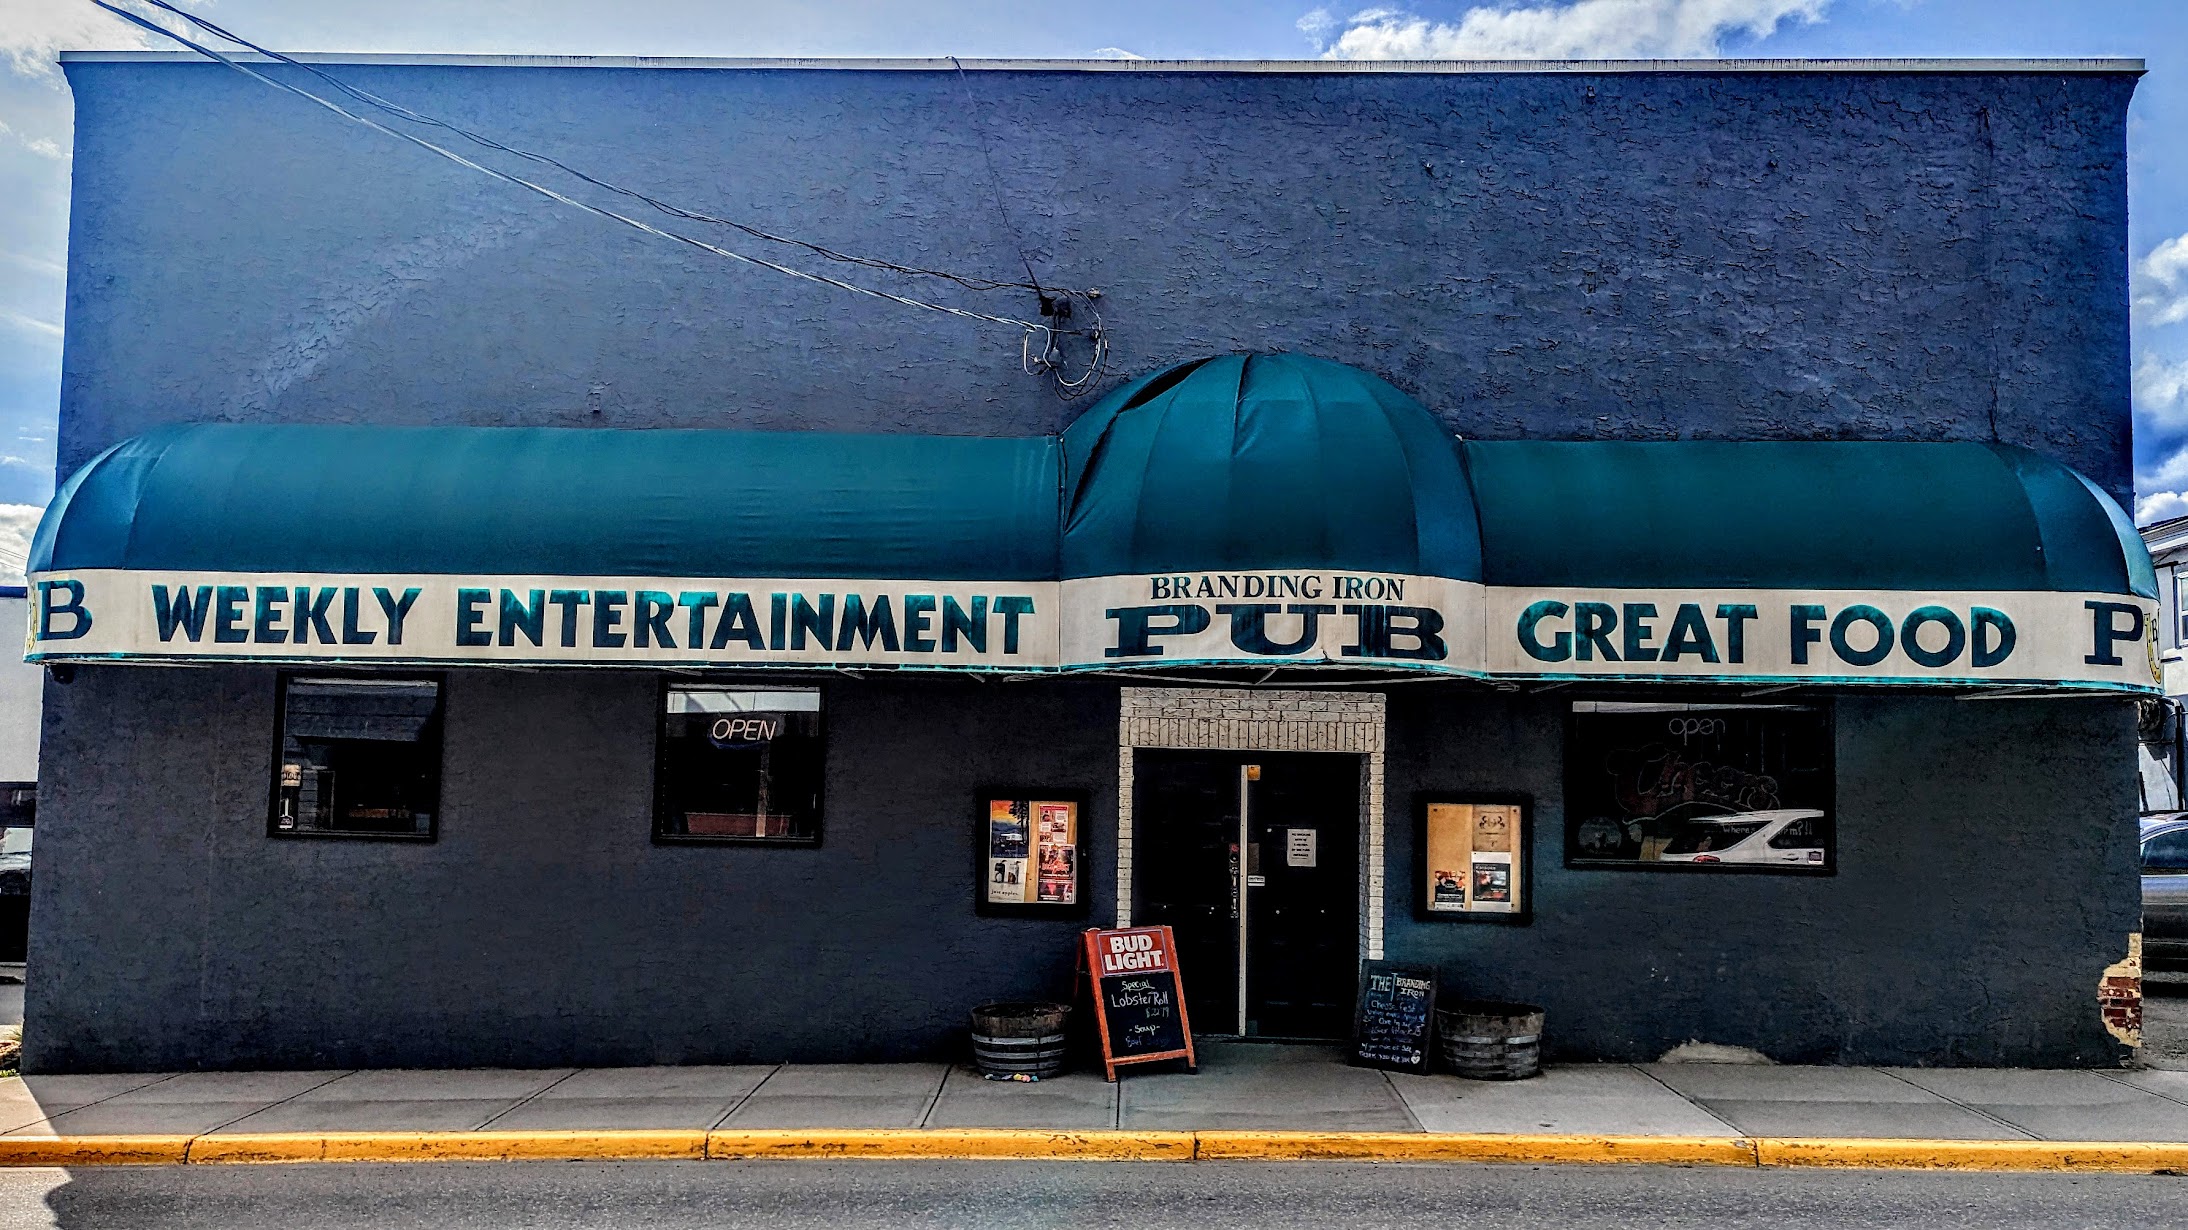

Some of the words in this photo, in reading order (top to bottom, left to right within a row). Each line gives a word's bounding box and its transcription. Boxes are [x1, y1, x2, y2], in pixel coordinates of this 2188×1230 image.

[1151, 574, 1323, 601] BRANDING
[1333, 576, 1405, 602] IRON
[152, 585, 423, 645] WEEKLY
[458, 587, 1034, 654] ENTERTAINMENT
[1105, 604, 1447, 660] PUB
[1516, 600, 1757, 664] GREAT
[1790, 604, 2017, 668] FOOD
[712, 718, 777, 742] OPEN
[1669, 718, 1725, 745] open
[1110, 935, 1153, 953] BUD
[1104, 951, 1163, 970] LIGHT
[1122, 979, 1150, 990] Special
[1370, 975, 1392, 992] THE
[1396, 977, 1431, 991] BRANDING
[1400, 988, 1424, 999] IRON
[1111, 992, 1151, 1007] Lobster
[1153, 991, 1168, 1005] Roll
